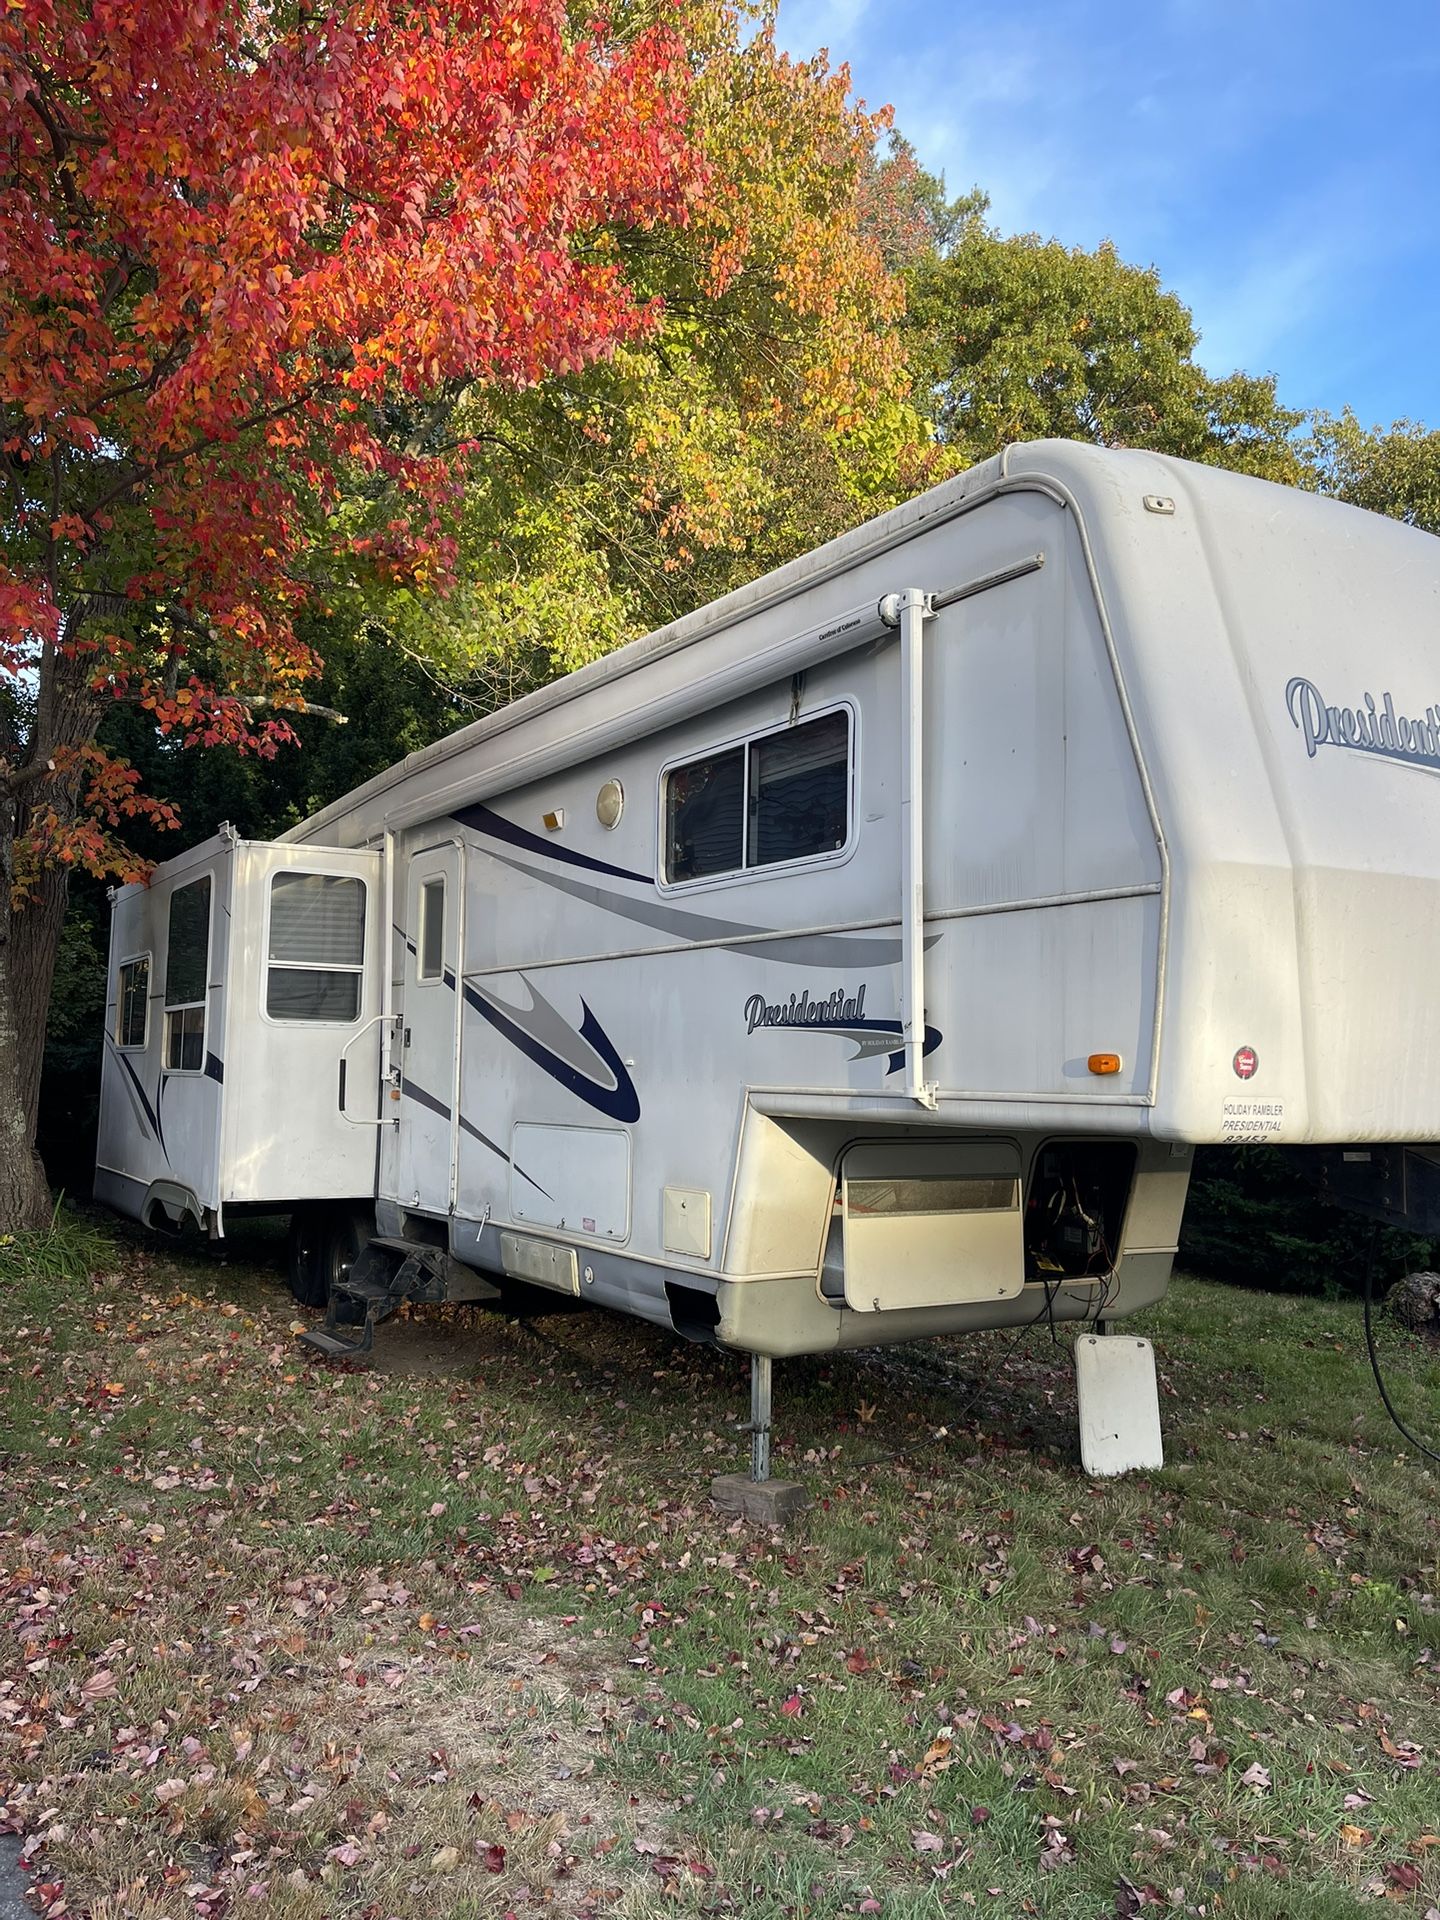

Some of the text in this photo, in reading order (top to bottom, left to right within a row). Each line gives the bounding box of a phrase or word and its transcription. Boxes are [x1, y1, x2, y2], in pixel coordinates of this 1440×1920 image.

[744, 984, 866, 1035] Presidential
[1223, 1104, 1283, 1116] HOLIDAY RAMBLER
[1222, 1120, 1281, 1131] PRESIDENTIAL
